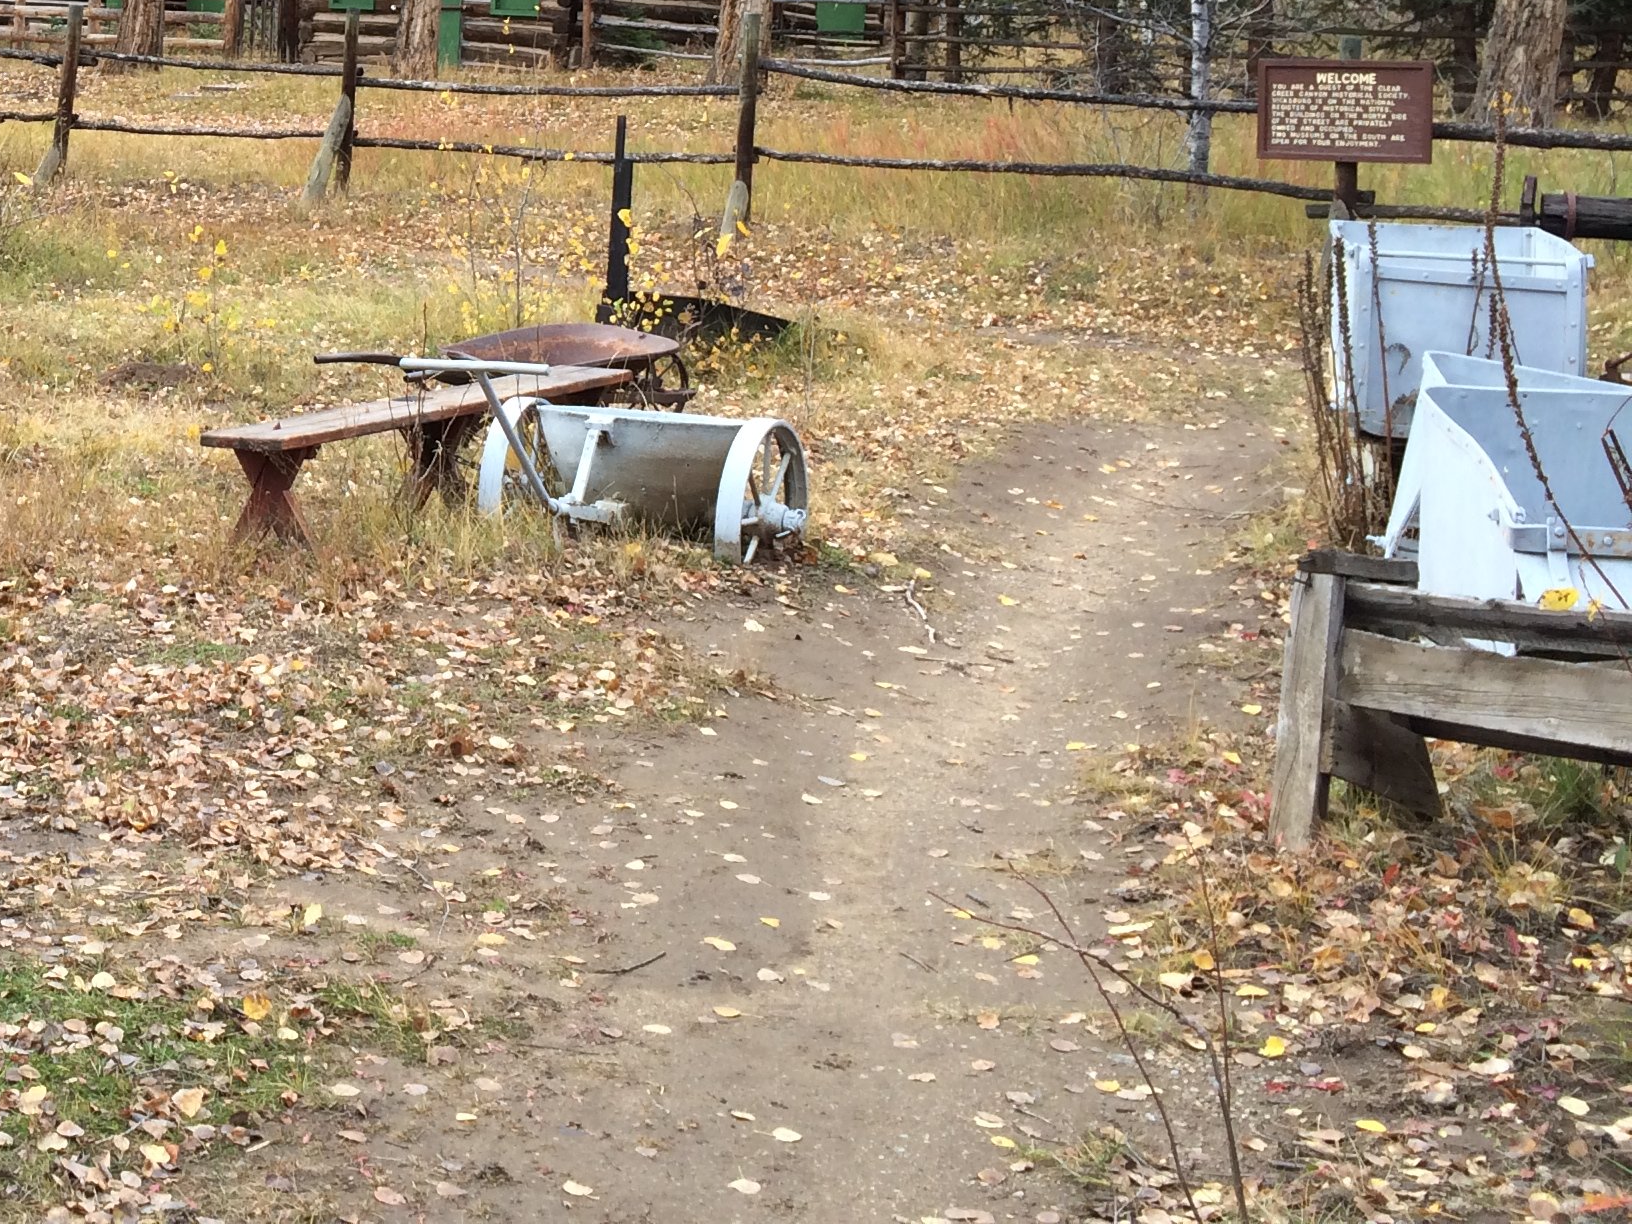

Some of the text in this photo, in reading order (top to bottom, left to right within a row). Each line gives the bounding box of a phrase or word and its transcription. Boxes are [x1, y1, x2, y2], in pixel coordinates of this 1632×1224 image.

[1316, 72, 1377, 85] WELCOME
[1298, 90, 1328, 98] CANYON
[1332, 91, 1374, 99] HISTORICAL
[1290, 131, 1325, 139] MUSEUMS
[1390, 134, 1406, 142] ARE
[1335, 140, 1381, 148] ENJOYMENT.
